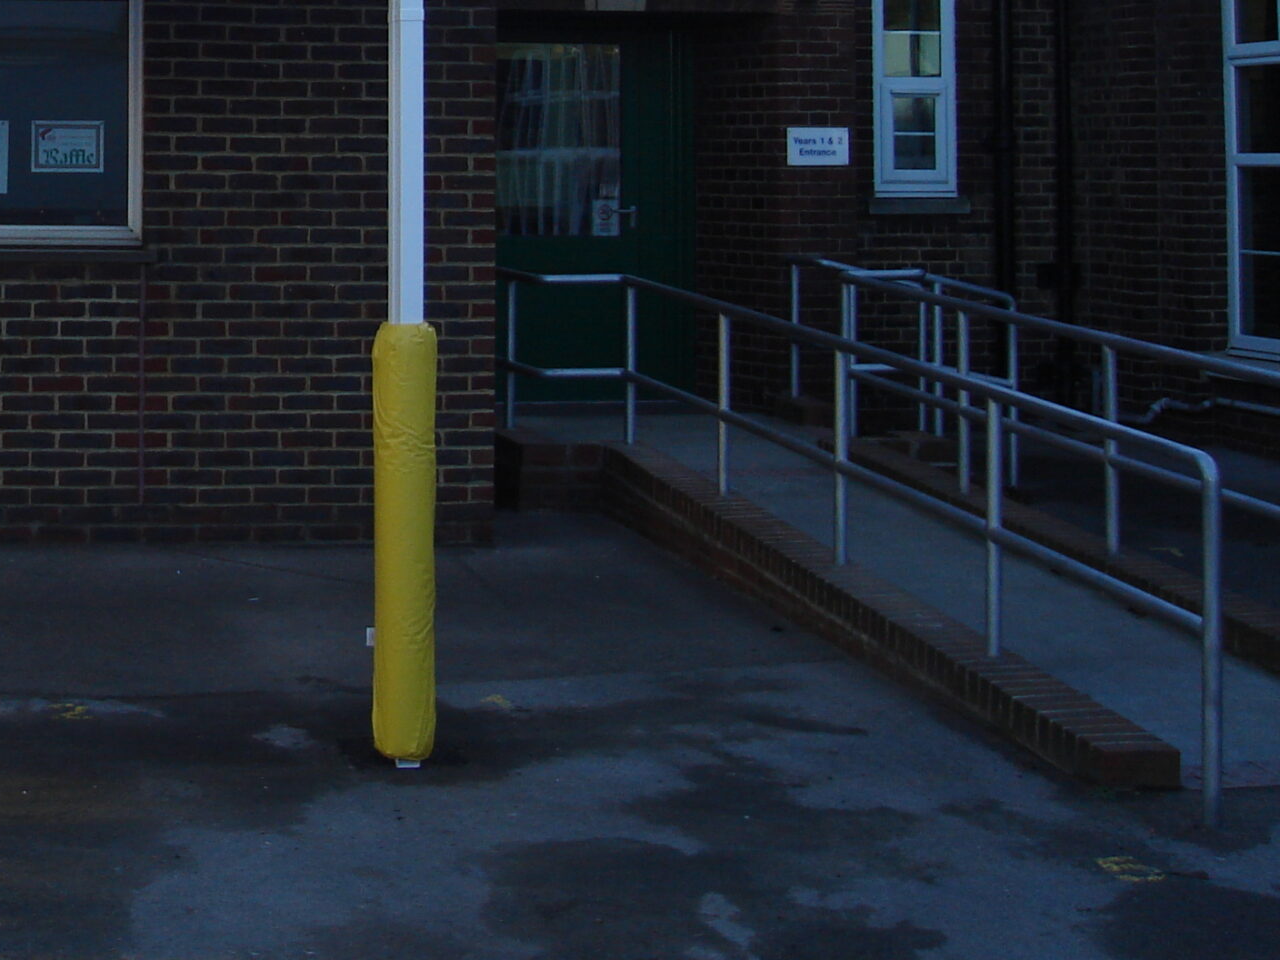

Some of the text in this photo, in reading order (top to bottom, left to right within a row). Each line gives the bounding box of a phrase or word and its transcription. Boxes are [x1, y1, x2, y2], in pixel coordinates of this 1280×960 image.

[793, 136, 817, 145] Years
[838, 136, 843, 145] 2
[43, 148, 95, 164] Raffle
[799, 147, 837, 156] Entrance
